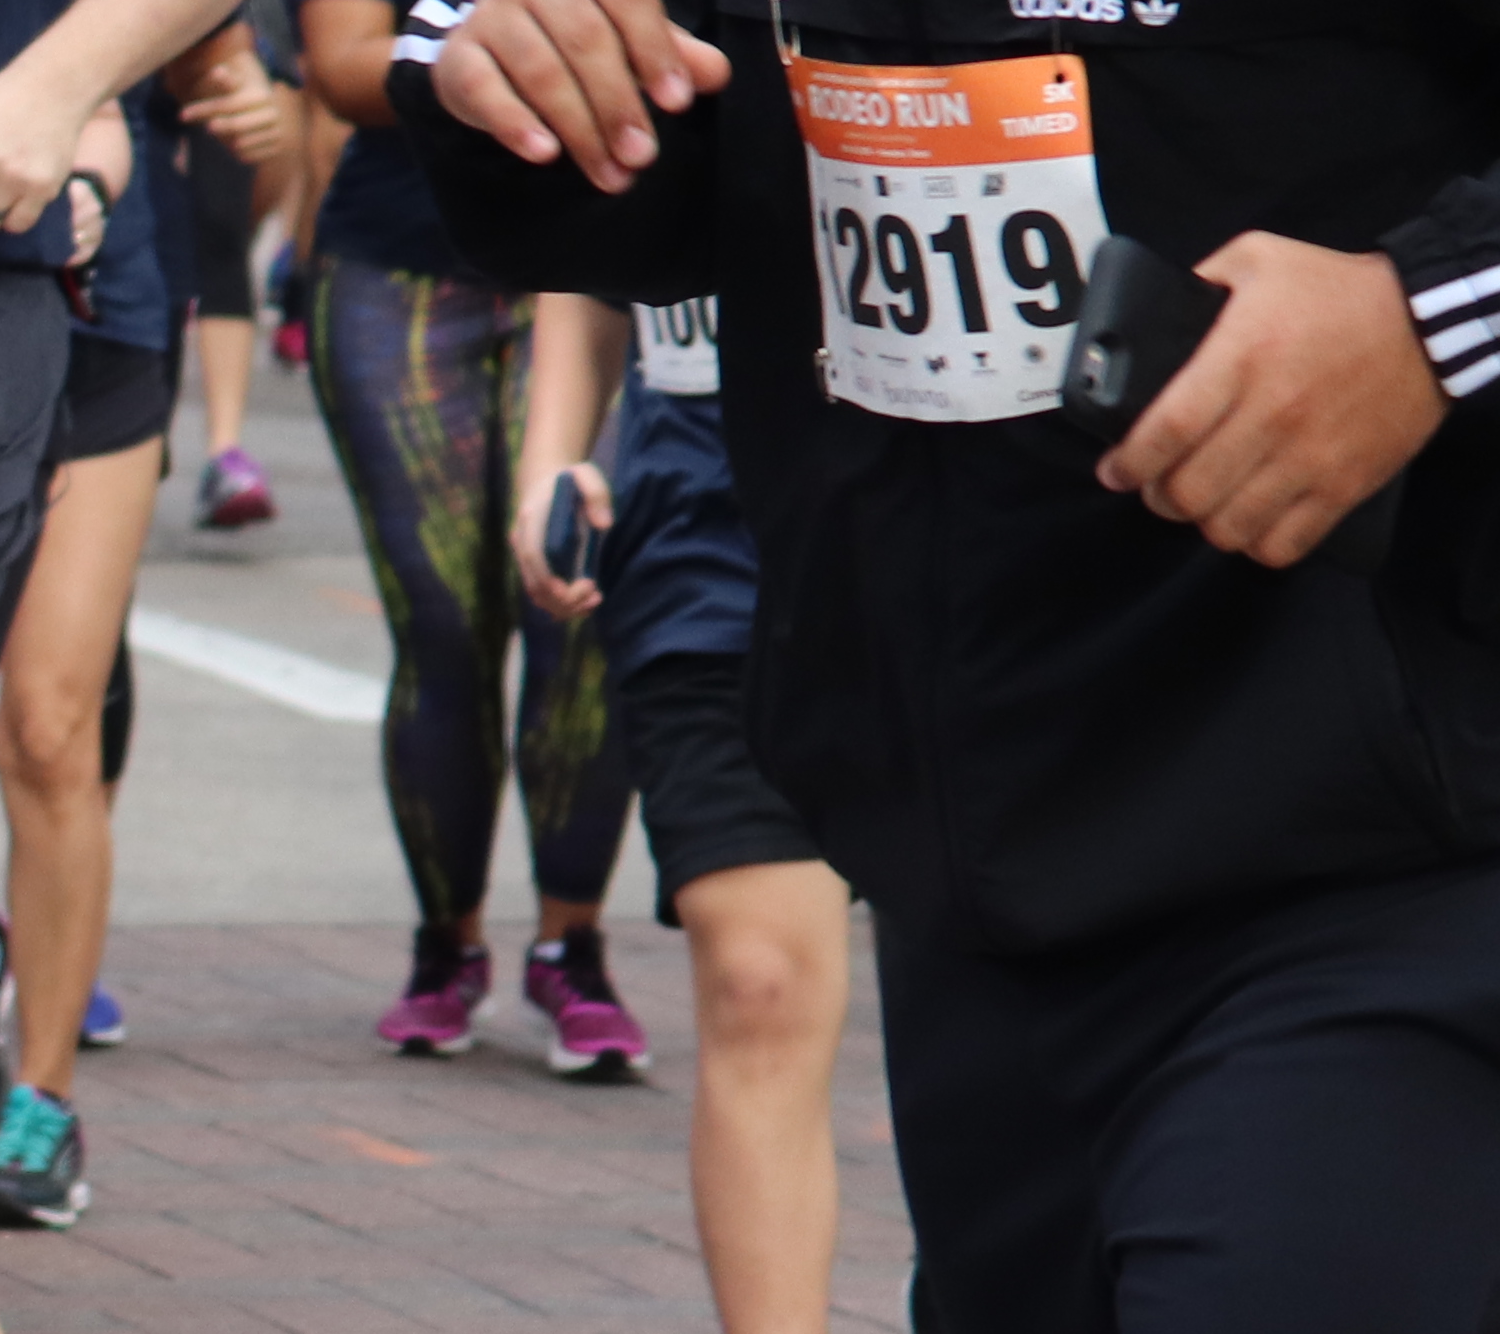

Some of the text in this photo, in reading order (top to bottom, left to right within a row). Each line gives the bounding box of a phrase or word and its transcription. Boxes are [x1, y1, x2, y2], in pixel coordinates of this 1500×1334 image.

[807, 82, 972, 129] RODEO RUN
[1000, 112, 1080, 139] TIMED
